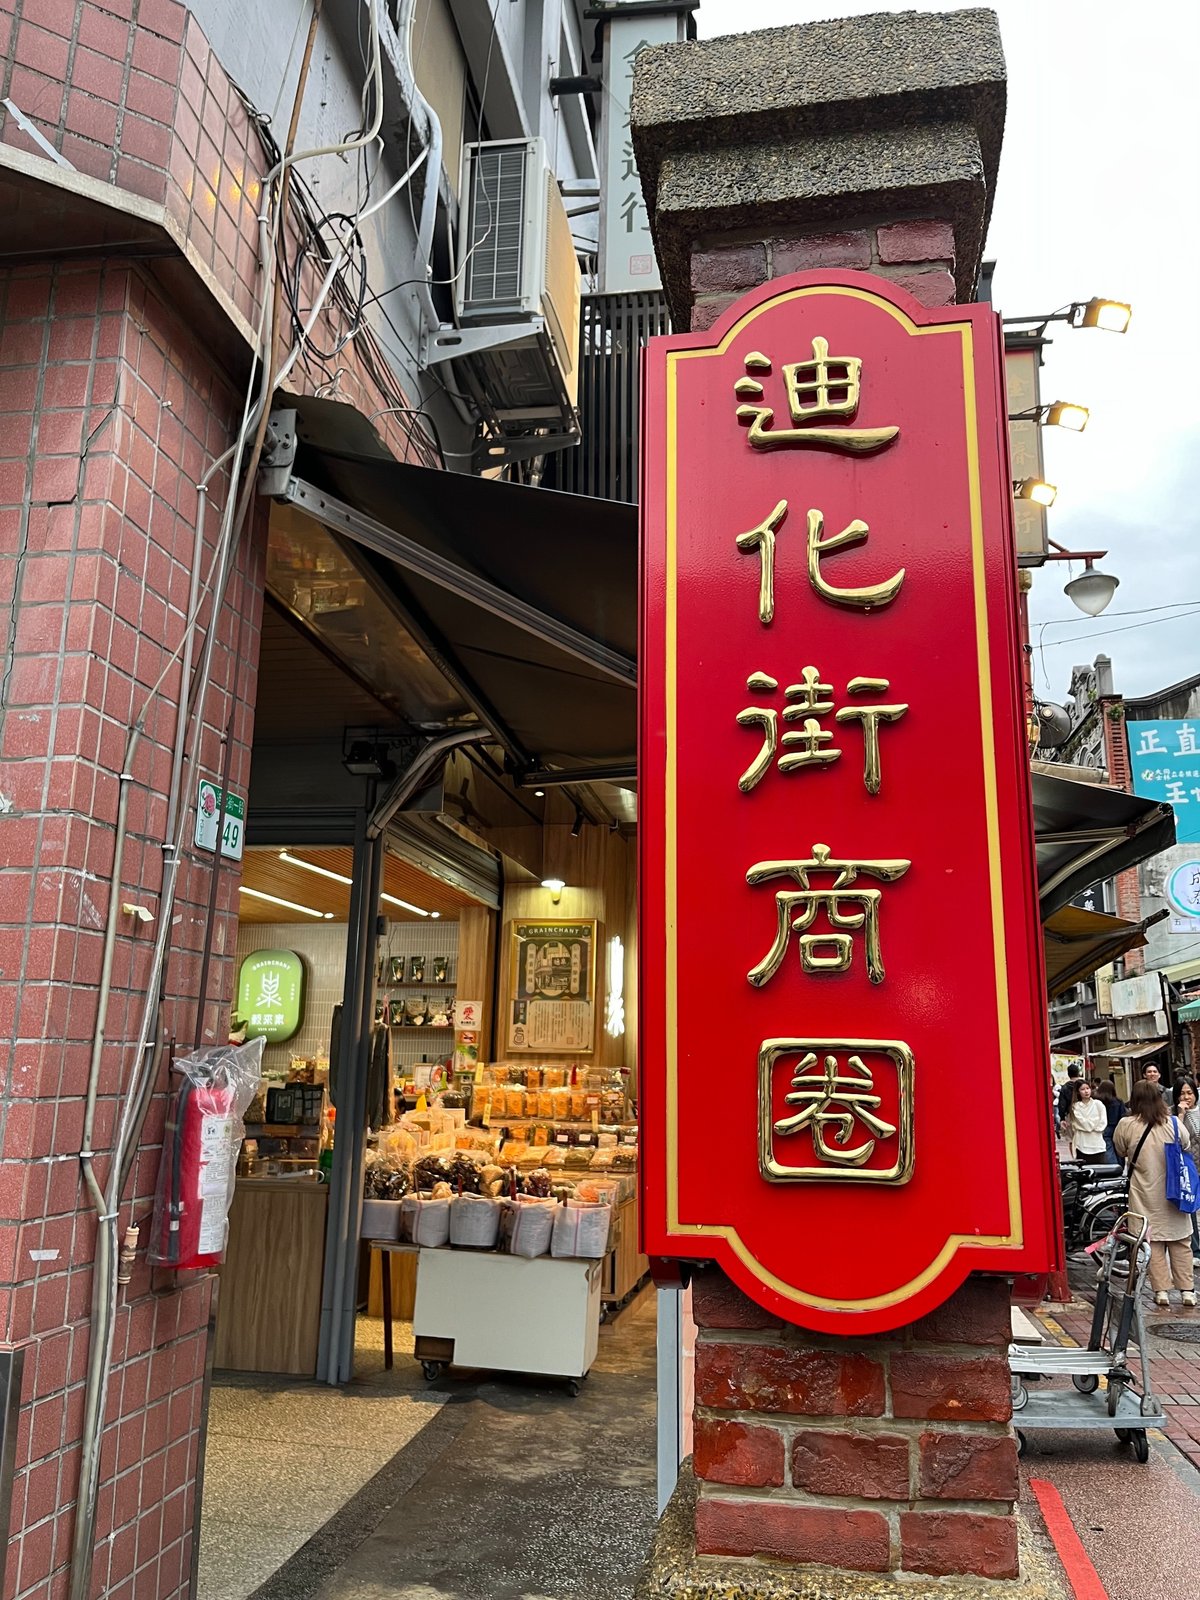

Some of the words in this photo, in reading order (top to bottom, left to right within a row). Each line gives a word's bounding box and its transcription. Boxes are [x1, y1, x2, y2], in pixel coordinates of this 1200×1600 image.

[1136, 723, 1200, 757] 正直
[734, 336, 916, 1186] 迪化街商圈
[528, 927, 580, 935] GRAINCHANT
